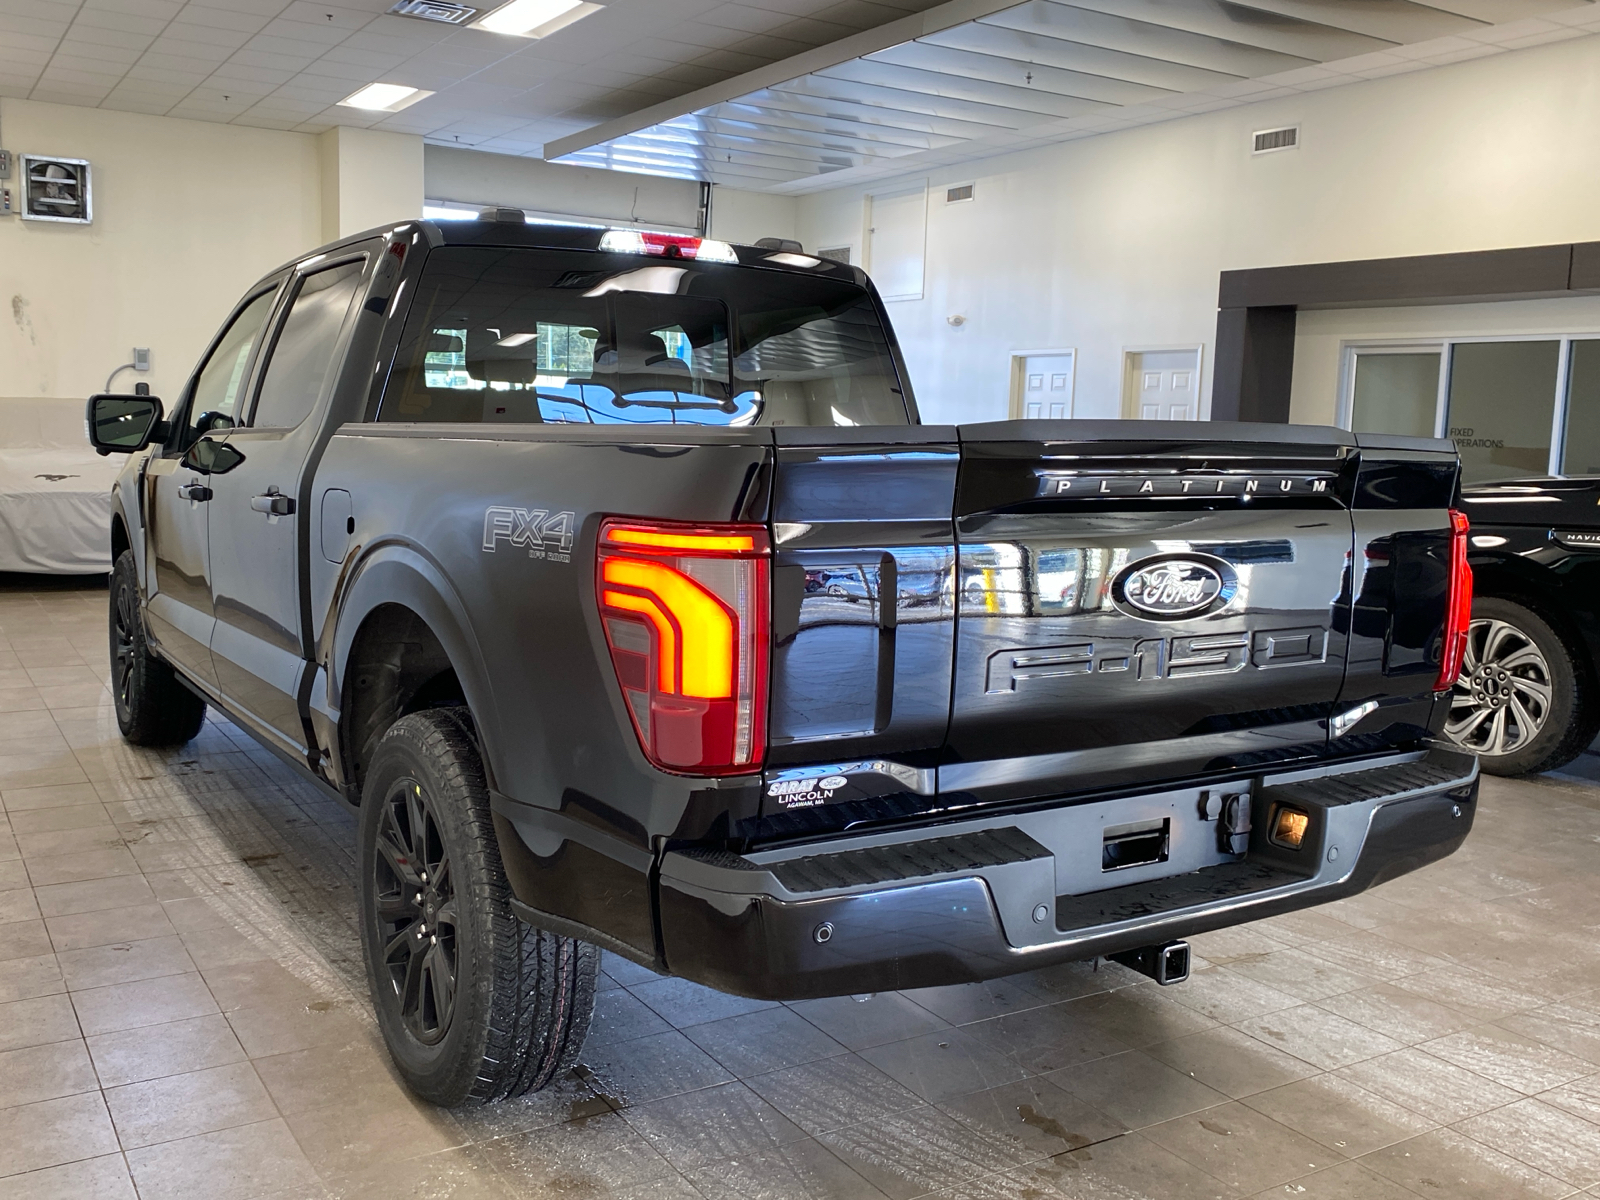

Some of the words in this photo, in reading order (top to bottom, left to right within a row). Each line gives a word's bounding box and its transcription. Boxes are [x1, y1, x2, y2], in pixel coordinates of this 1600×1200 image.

[1450, 428, 1474, 437] FIXED
[1455, 438, 1504, 449] PERATIONS
[1056, 480, 1327, 494] PLATINUM
[482, 505, 575, 552] FX4
[1142, 569, 1206, 604] Ford
[984, 624, 1329, 695] F-150
[767, 779, 818, 796] SARAT
[778, 790, 833, 804] LINCOLN
